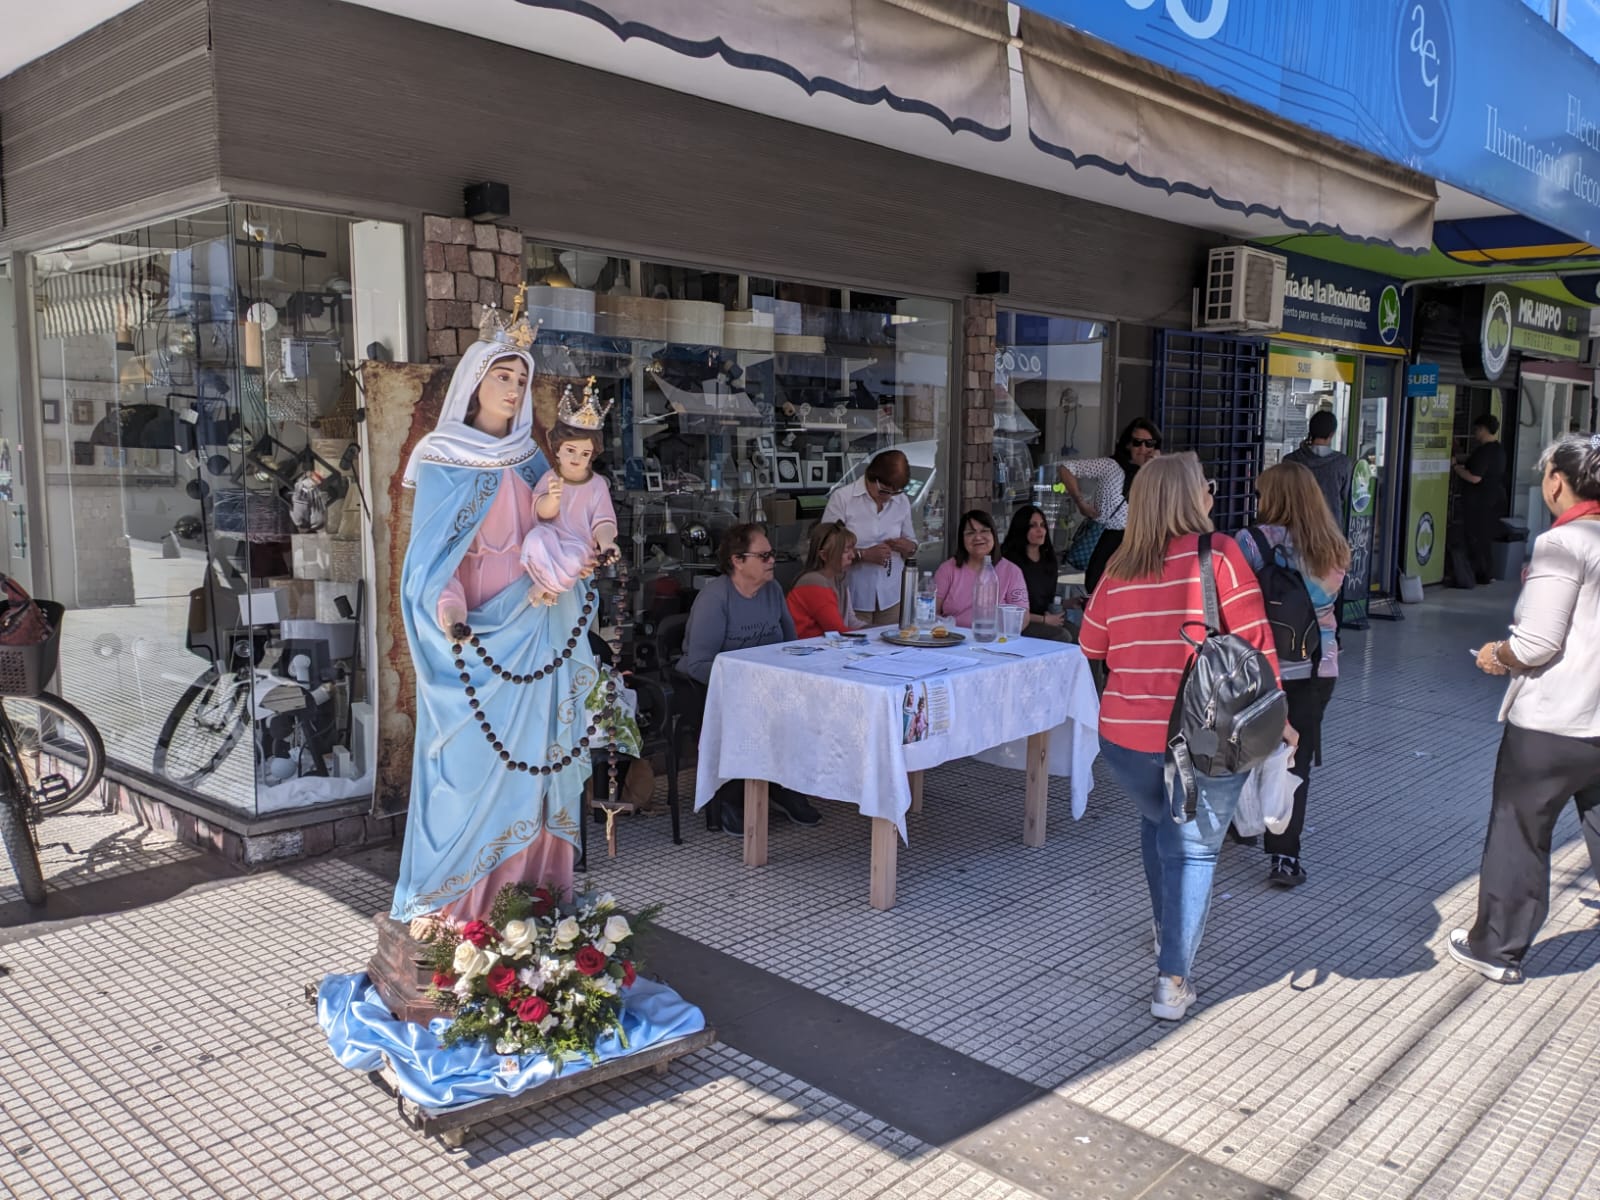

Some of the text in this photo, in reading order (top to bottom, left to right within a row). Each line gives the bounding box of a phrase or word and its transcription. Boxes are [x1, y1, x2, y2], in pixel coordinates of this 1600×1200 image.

[1483, 103, 1600, 208] Iluminación deco
[1285, 272, 1371, 312] ría de la Provincia
[1298, 310, 1310, 321] para
[1320, 312, 1343, 326] Beneficios
[1343, 318, 1354, 329] para
[1518, 297, 1561, 331] MR.HIPPO
[1408, 374, 1437, 385] SUBE
